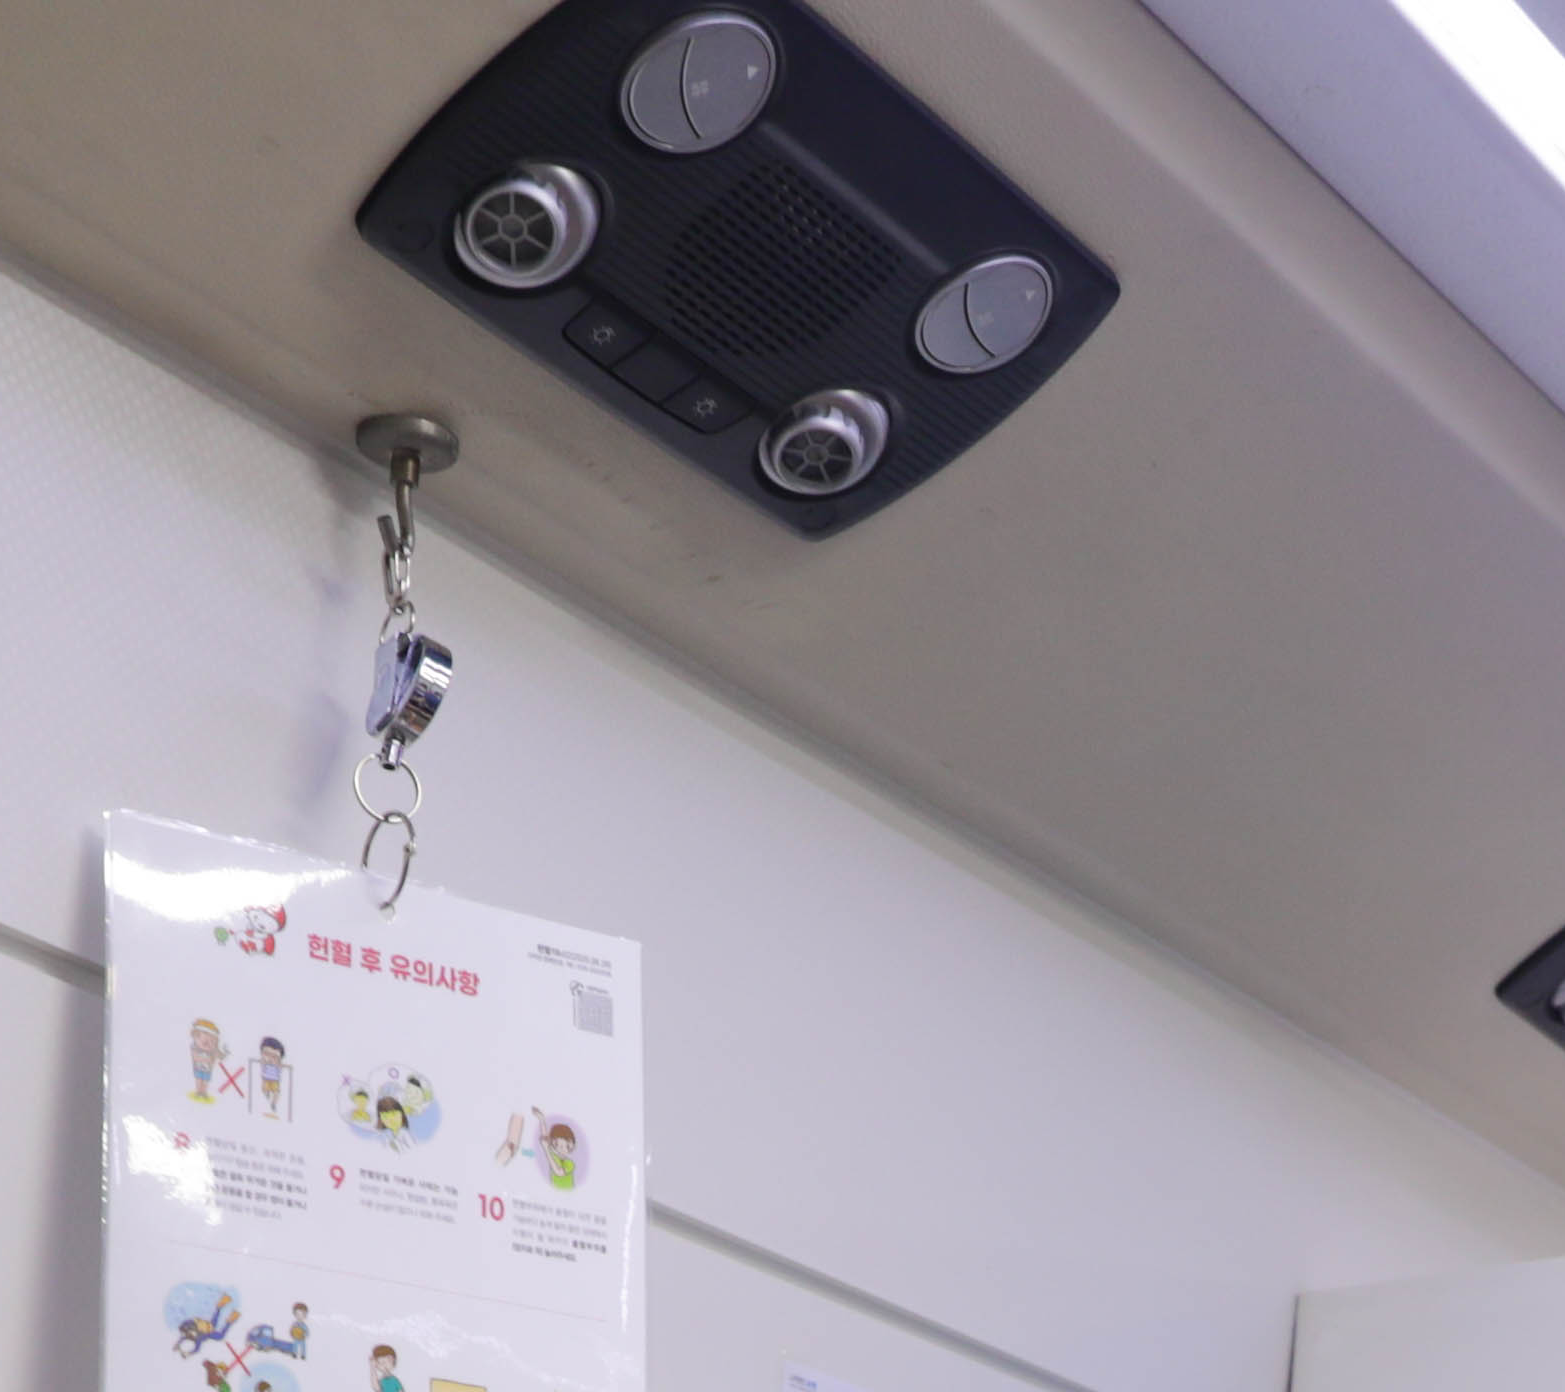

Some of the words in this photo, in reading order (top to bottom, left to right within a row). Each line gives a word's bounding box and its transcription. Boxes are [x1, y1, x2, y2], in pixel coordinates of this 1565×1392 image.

[307, 933, 352, 968] 헌혈
[360, 947, 382, 974] 후
[390, 954, 480, 997] 유의사항
[329, 1164, 345, 1189] 9
[478, 1193, 504, 1221] 10
